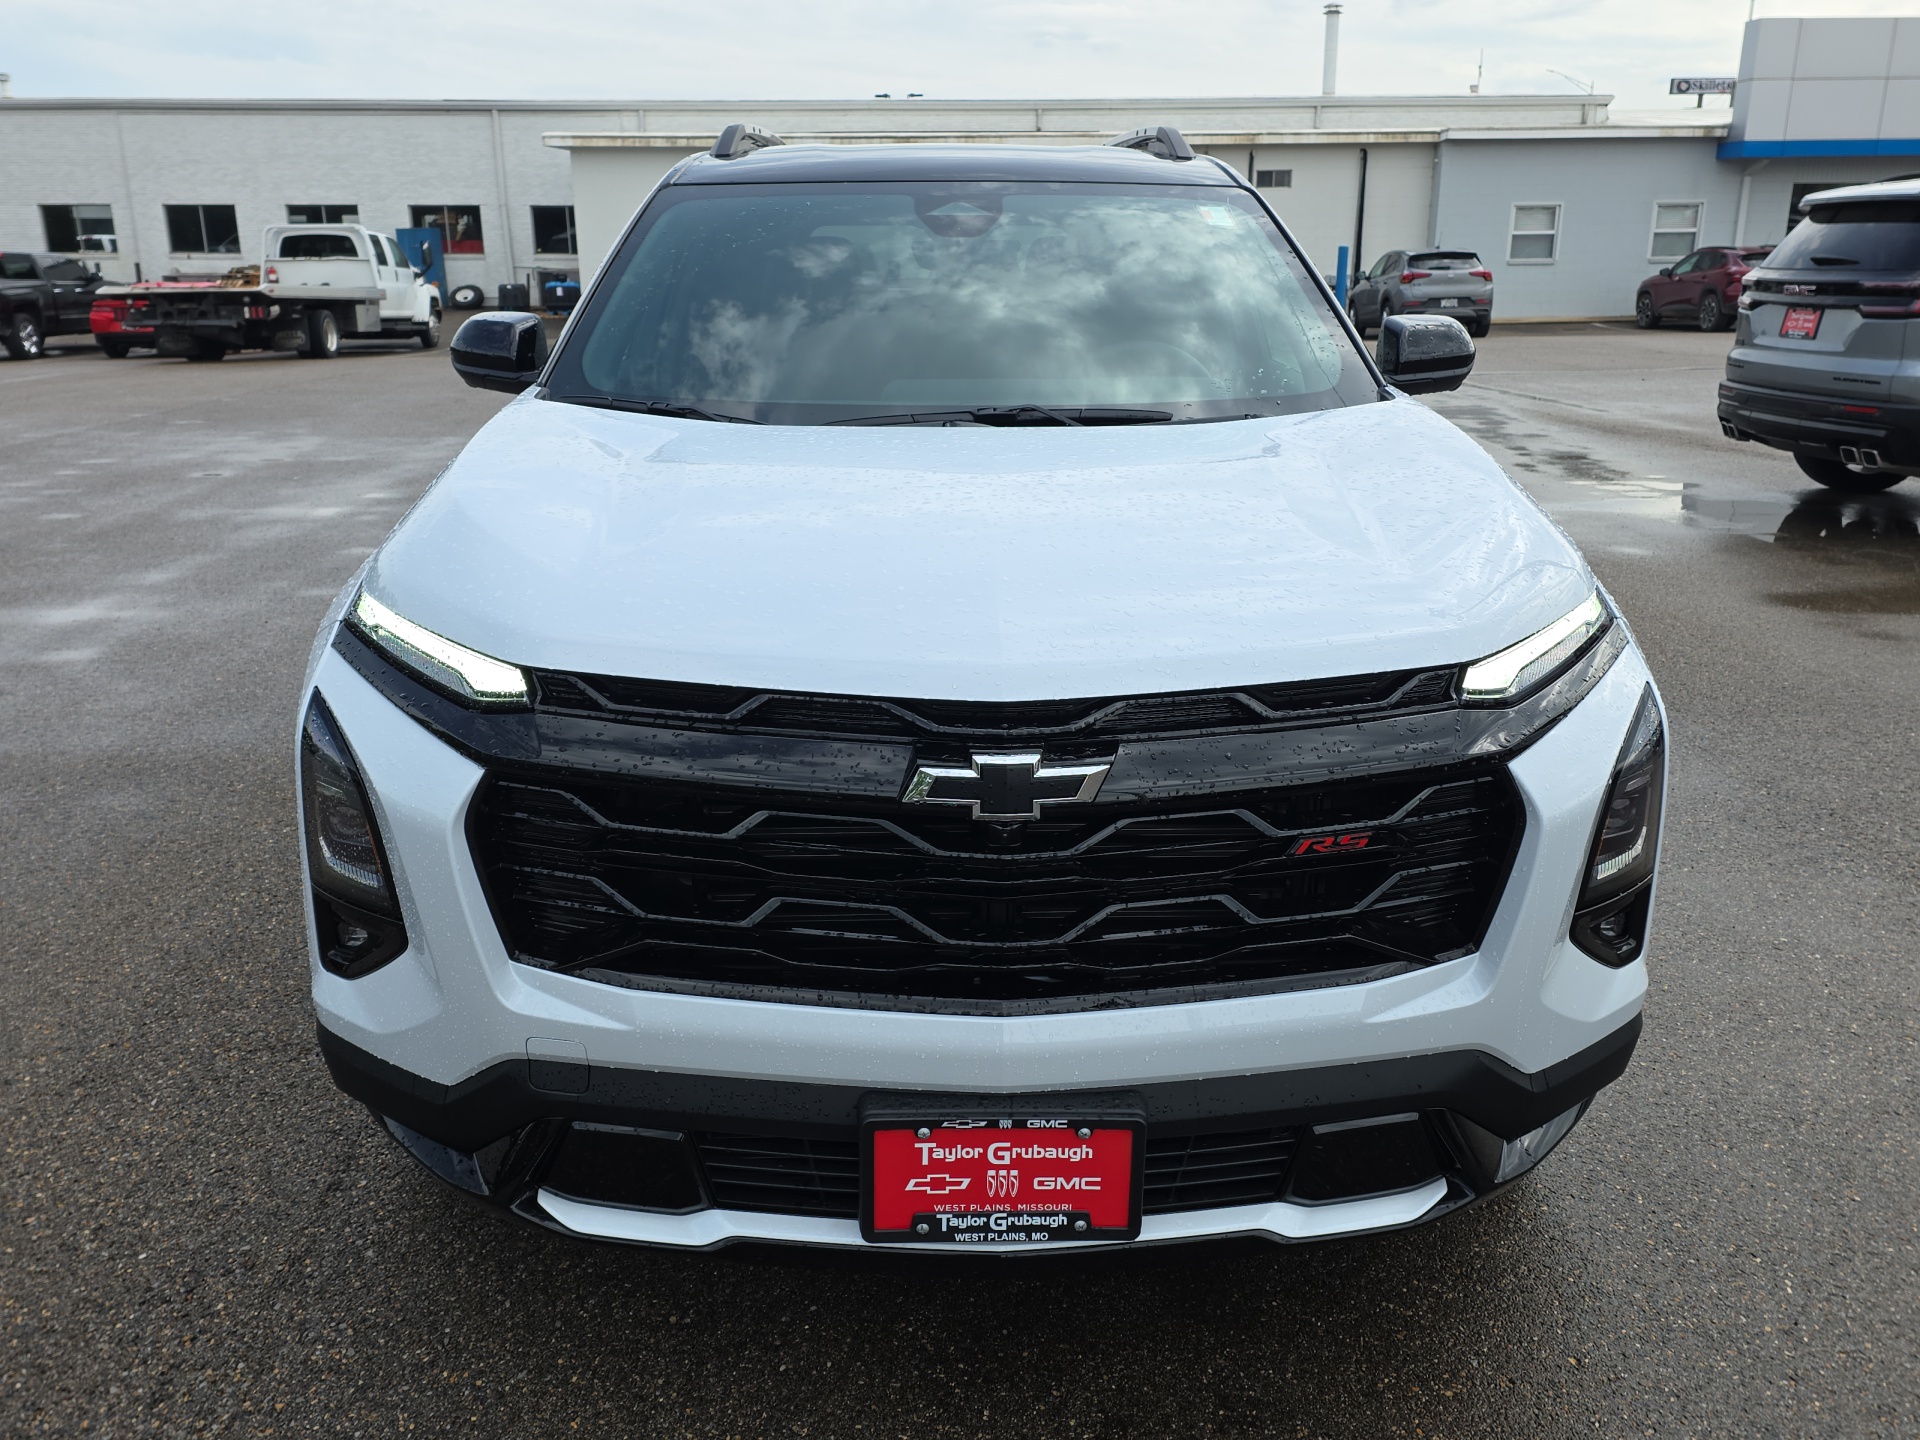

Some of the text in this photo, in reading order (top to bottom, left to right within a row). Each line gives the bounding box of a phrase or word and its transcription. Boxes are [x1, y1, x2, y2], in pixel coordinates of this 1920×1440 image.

[1783, 284, 1816, 296] GMC
[1284, 831, 1372, 856] RS
[1026, 1119, 1068, 1128] GMC
[914, 1142, 1093, 1165] Taylor Grubaugh
[1033, 1177, 1102, 1190] GMC
[933, 1204, 966, 1212] WEST
[1017, 1203, 1073, 1212] MISSOURI
[936, 1213, 1068, 1232] Taylor Grubaugh
[954, 1232, 1049, 1242] WEST PLAINS, MO
